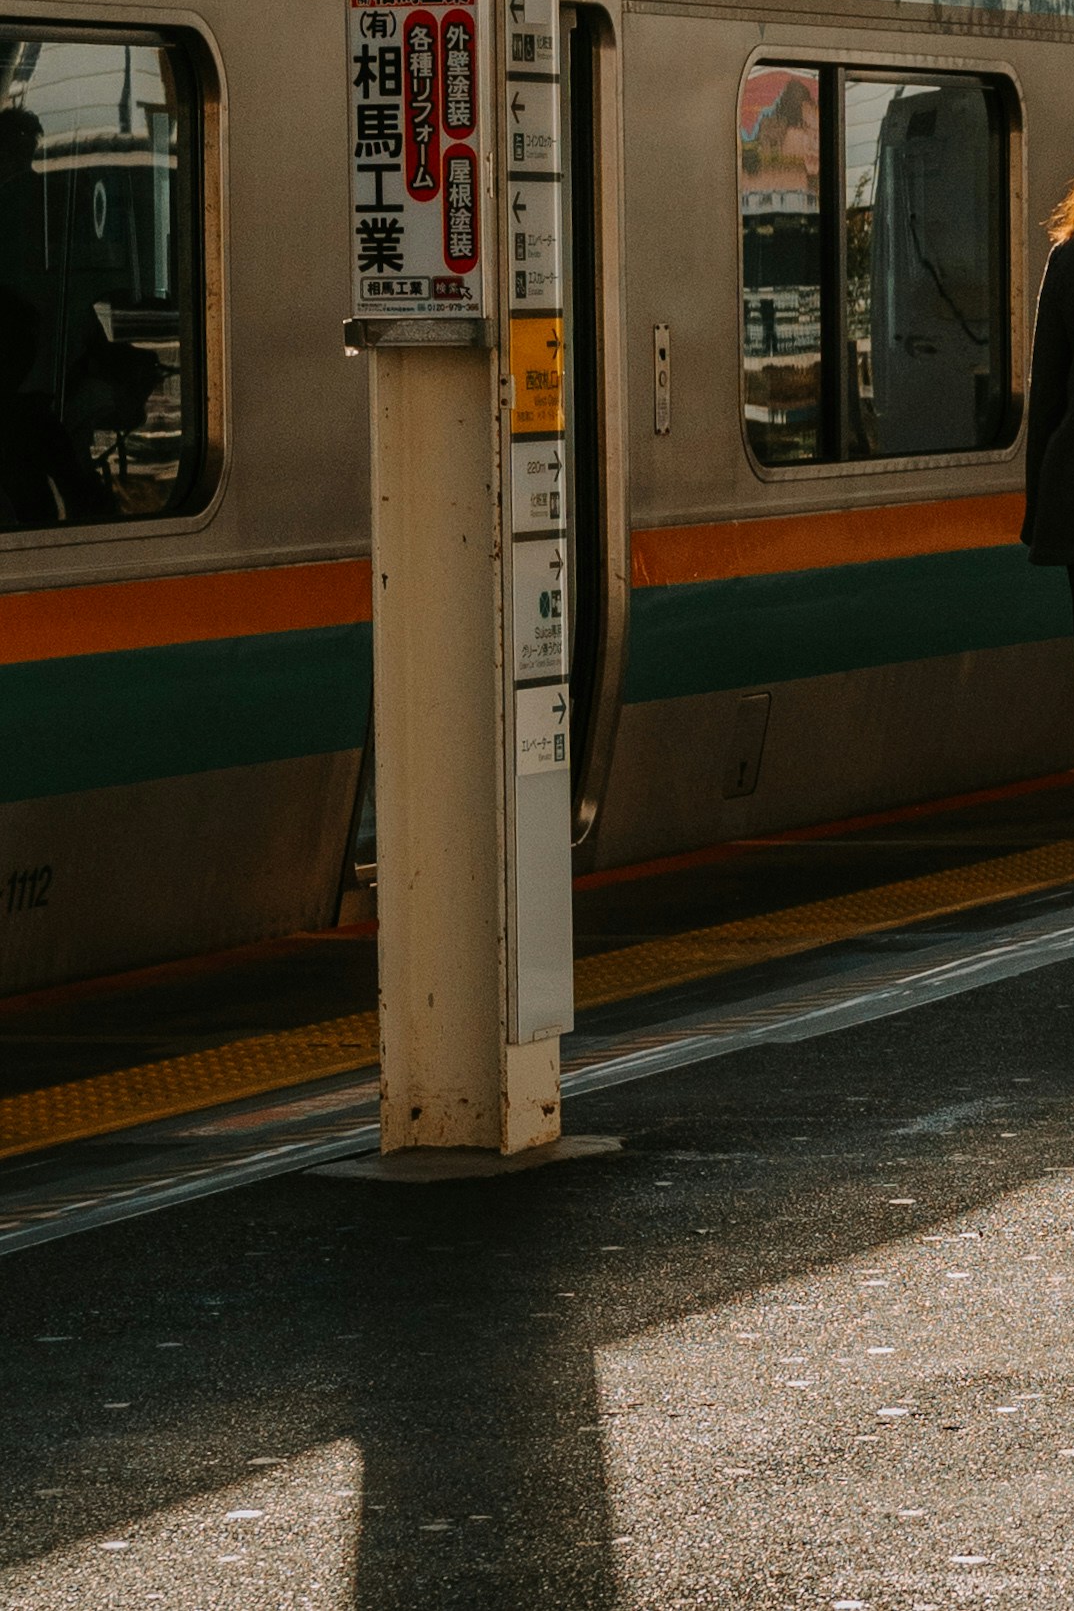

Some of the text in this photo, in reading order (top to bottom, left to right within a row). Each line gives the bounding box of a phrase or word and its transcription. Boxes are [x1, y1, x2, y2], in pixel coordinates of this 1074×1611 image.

[410, 25, 435, 189] 各種リフォーム
[446, 25, 471, 127] 外壁塗装
[448, 158, 473, 258] 屋根塗装
[366, 280, 424, 296] 相馬工業
